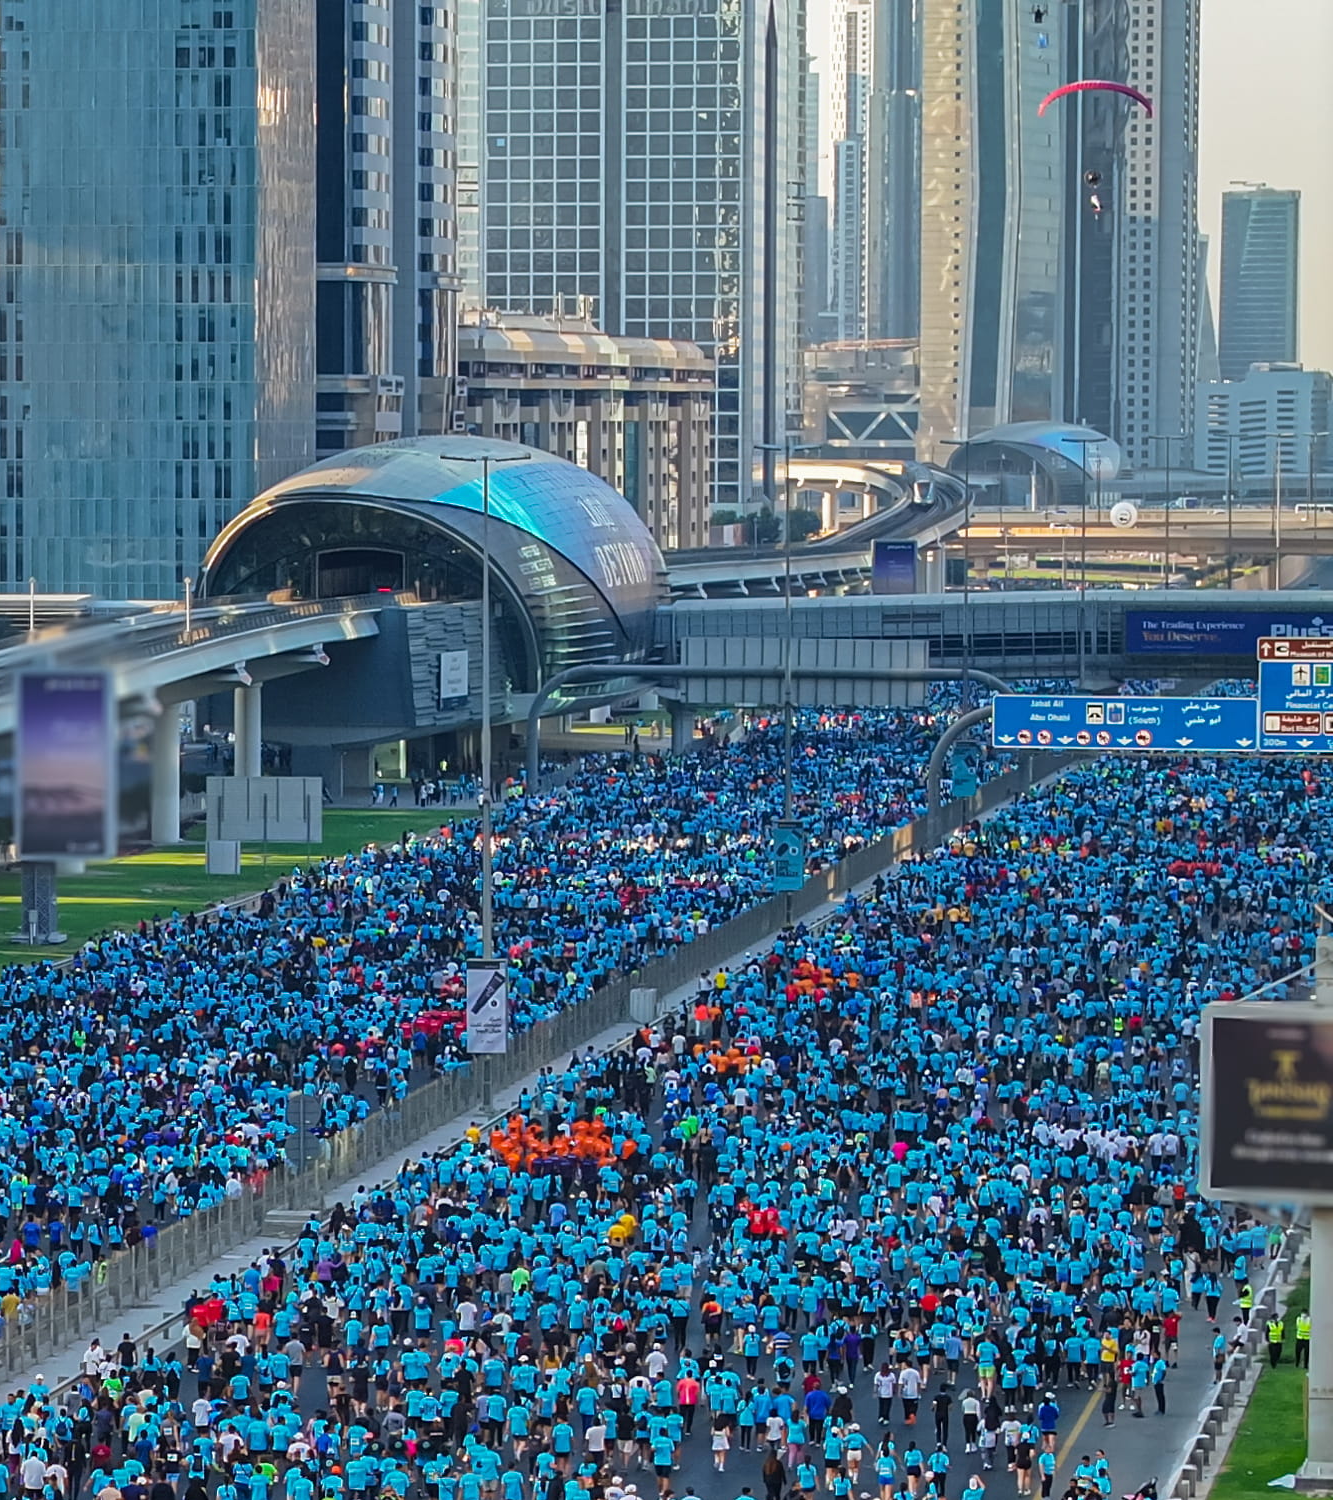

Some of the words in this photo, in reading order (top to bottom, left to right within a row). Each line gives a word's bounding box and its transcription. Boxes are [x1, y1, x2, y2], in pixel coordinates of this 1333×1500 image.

[1142, 621, 1154, 629] The
[1161, 621, 1195, 630] Trading
[1196, 621, 1245, 630] Experience
[1142, 632, 1165, 641] You
